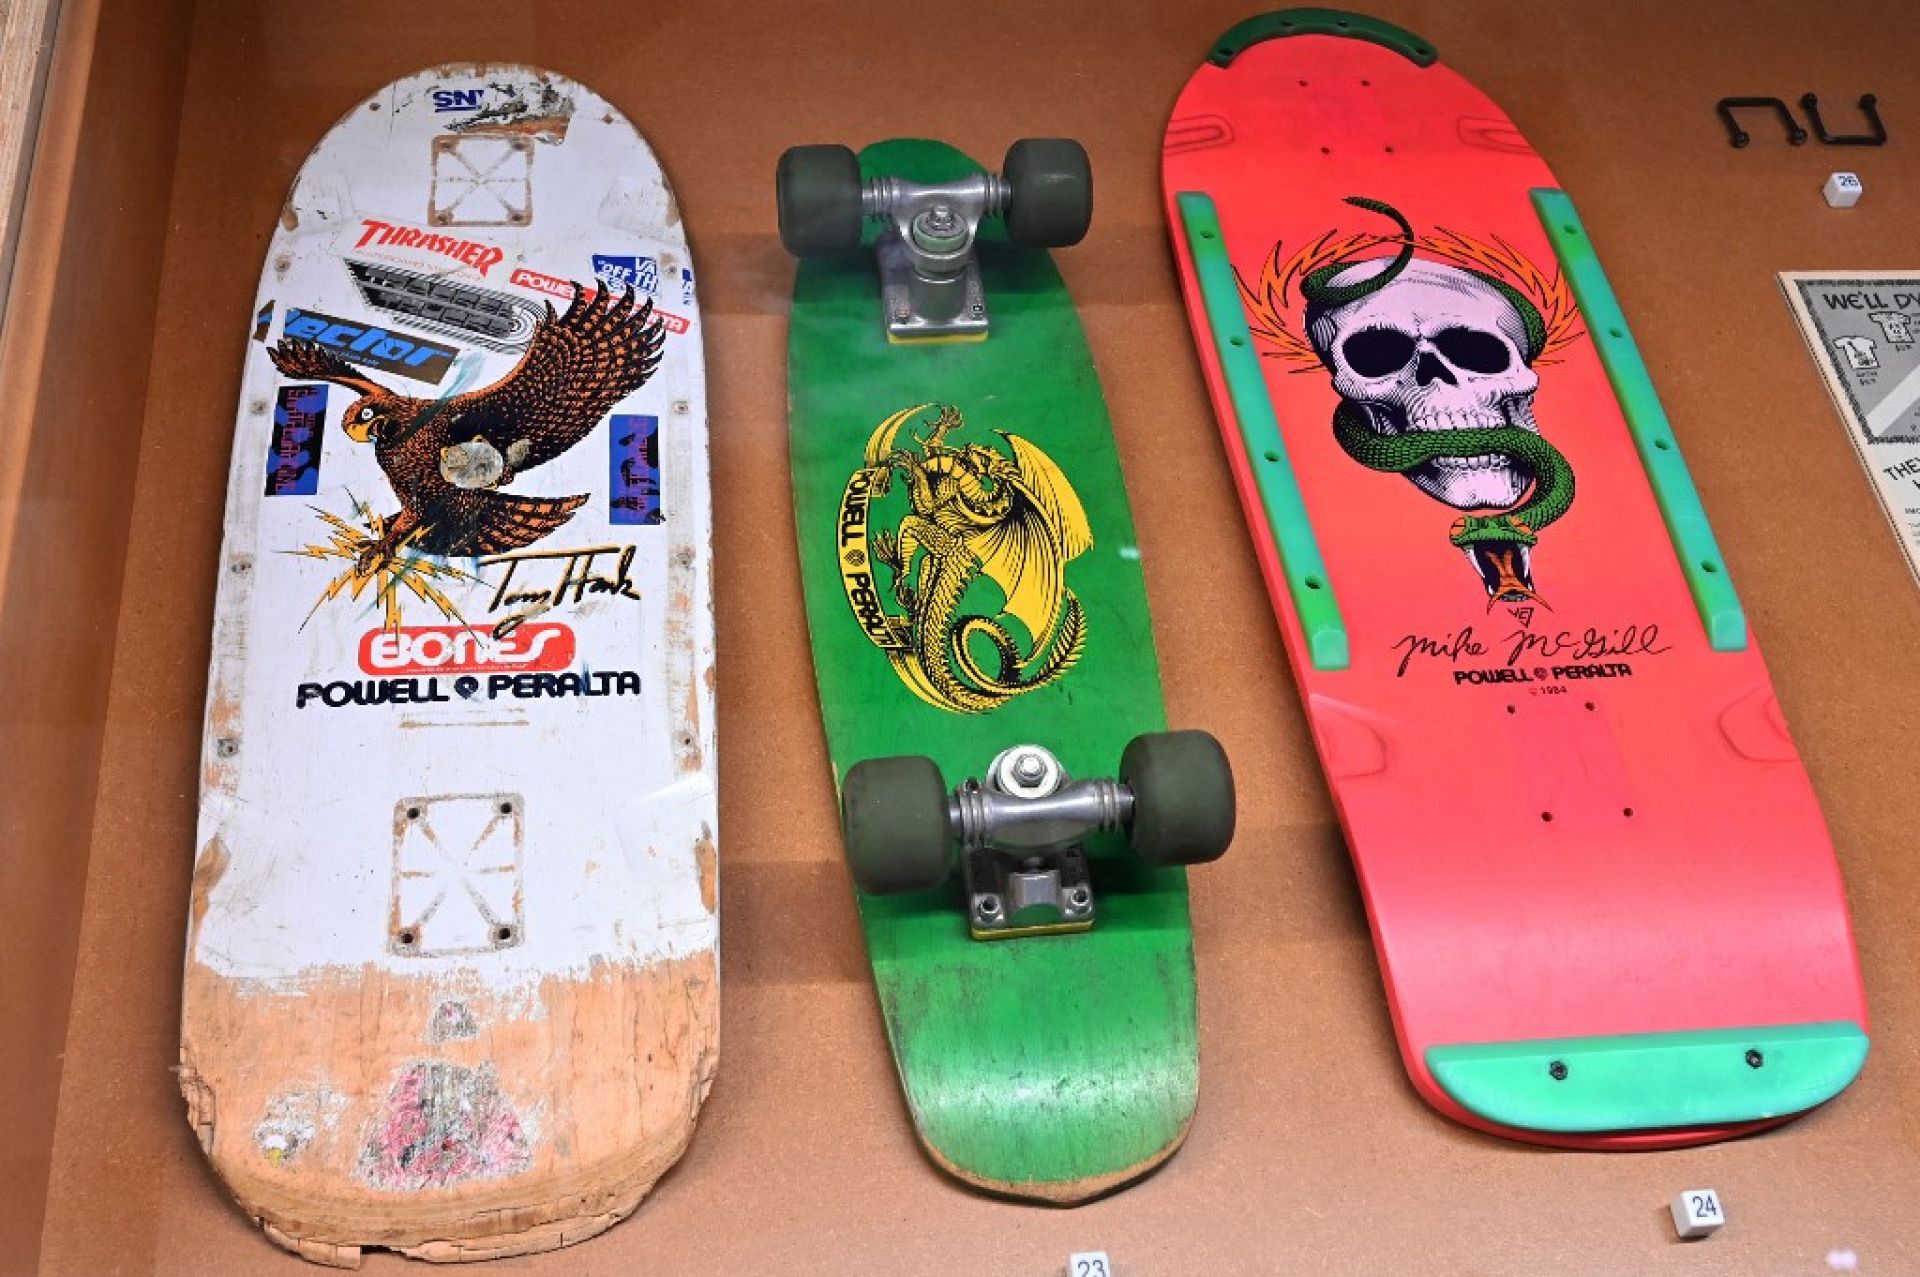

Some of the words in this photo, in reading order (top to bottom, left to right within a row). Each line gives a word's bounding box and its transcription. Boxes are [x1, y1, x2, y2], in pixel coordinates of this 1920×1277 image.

[355, 219, 503, 278] THRASHER
[1822, 291, 1889, 310] WE'LL
[1453, 668, 1535, 685] POWELL
[1551, 663, 1633, 680] PERALTA
[297, 677, 450, 708] POWELL
[488, 671, 641, 699] PERALTA
[1692, 1194, 1717, 1218] 24
[1077, 1259, 1107, 1277] 23
